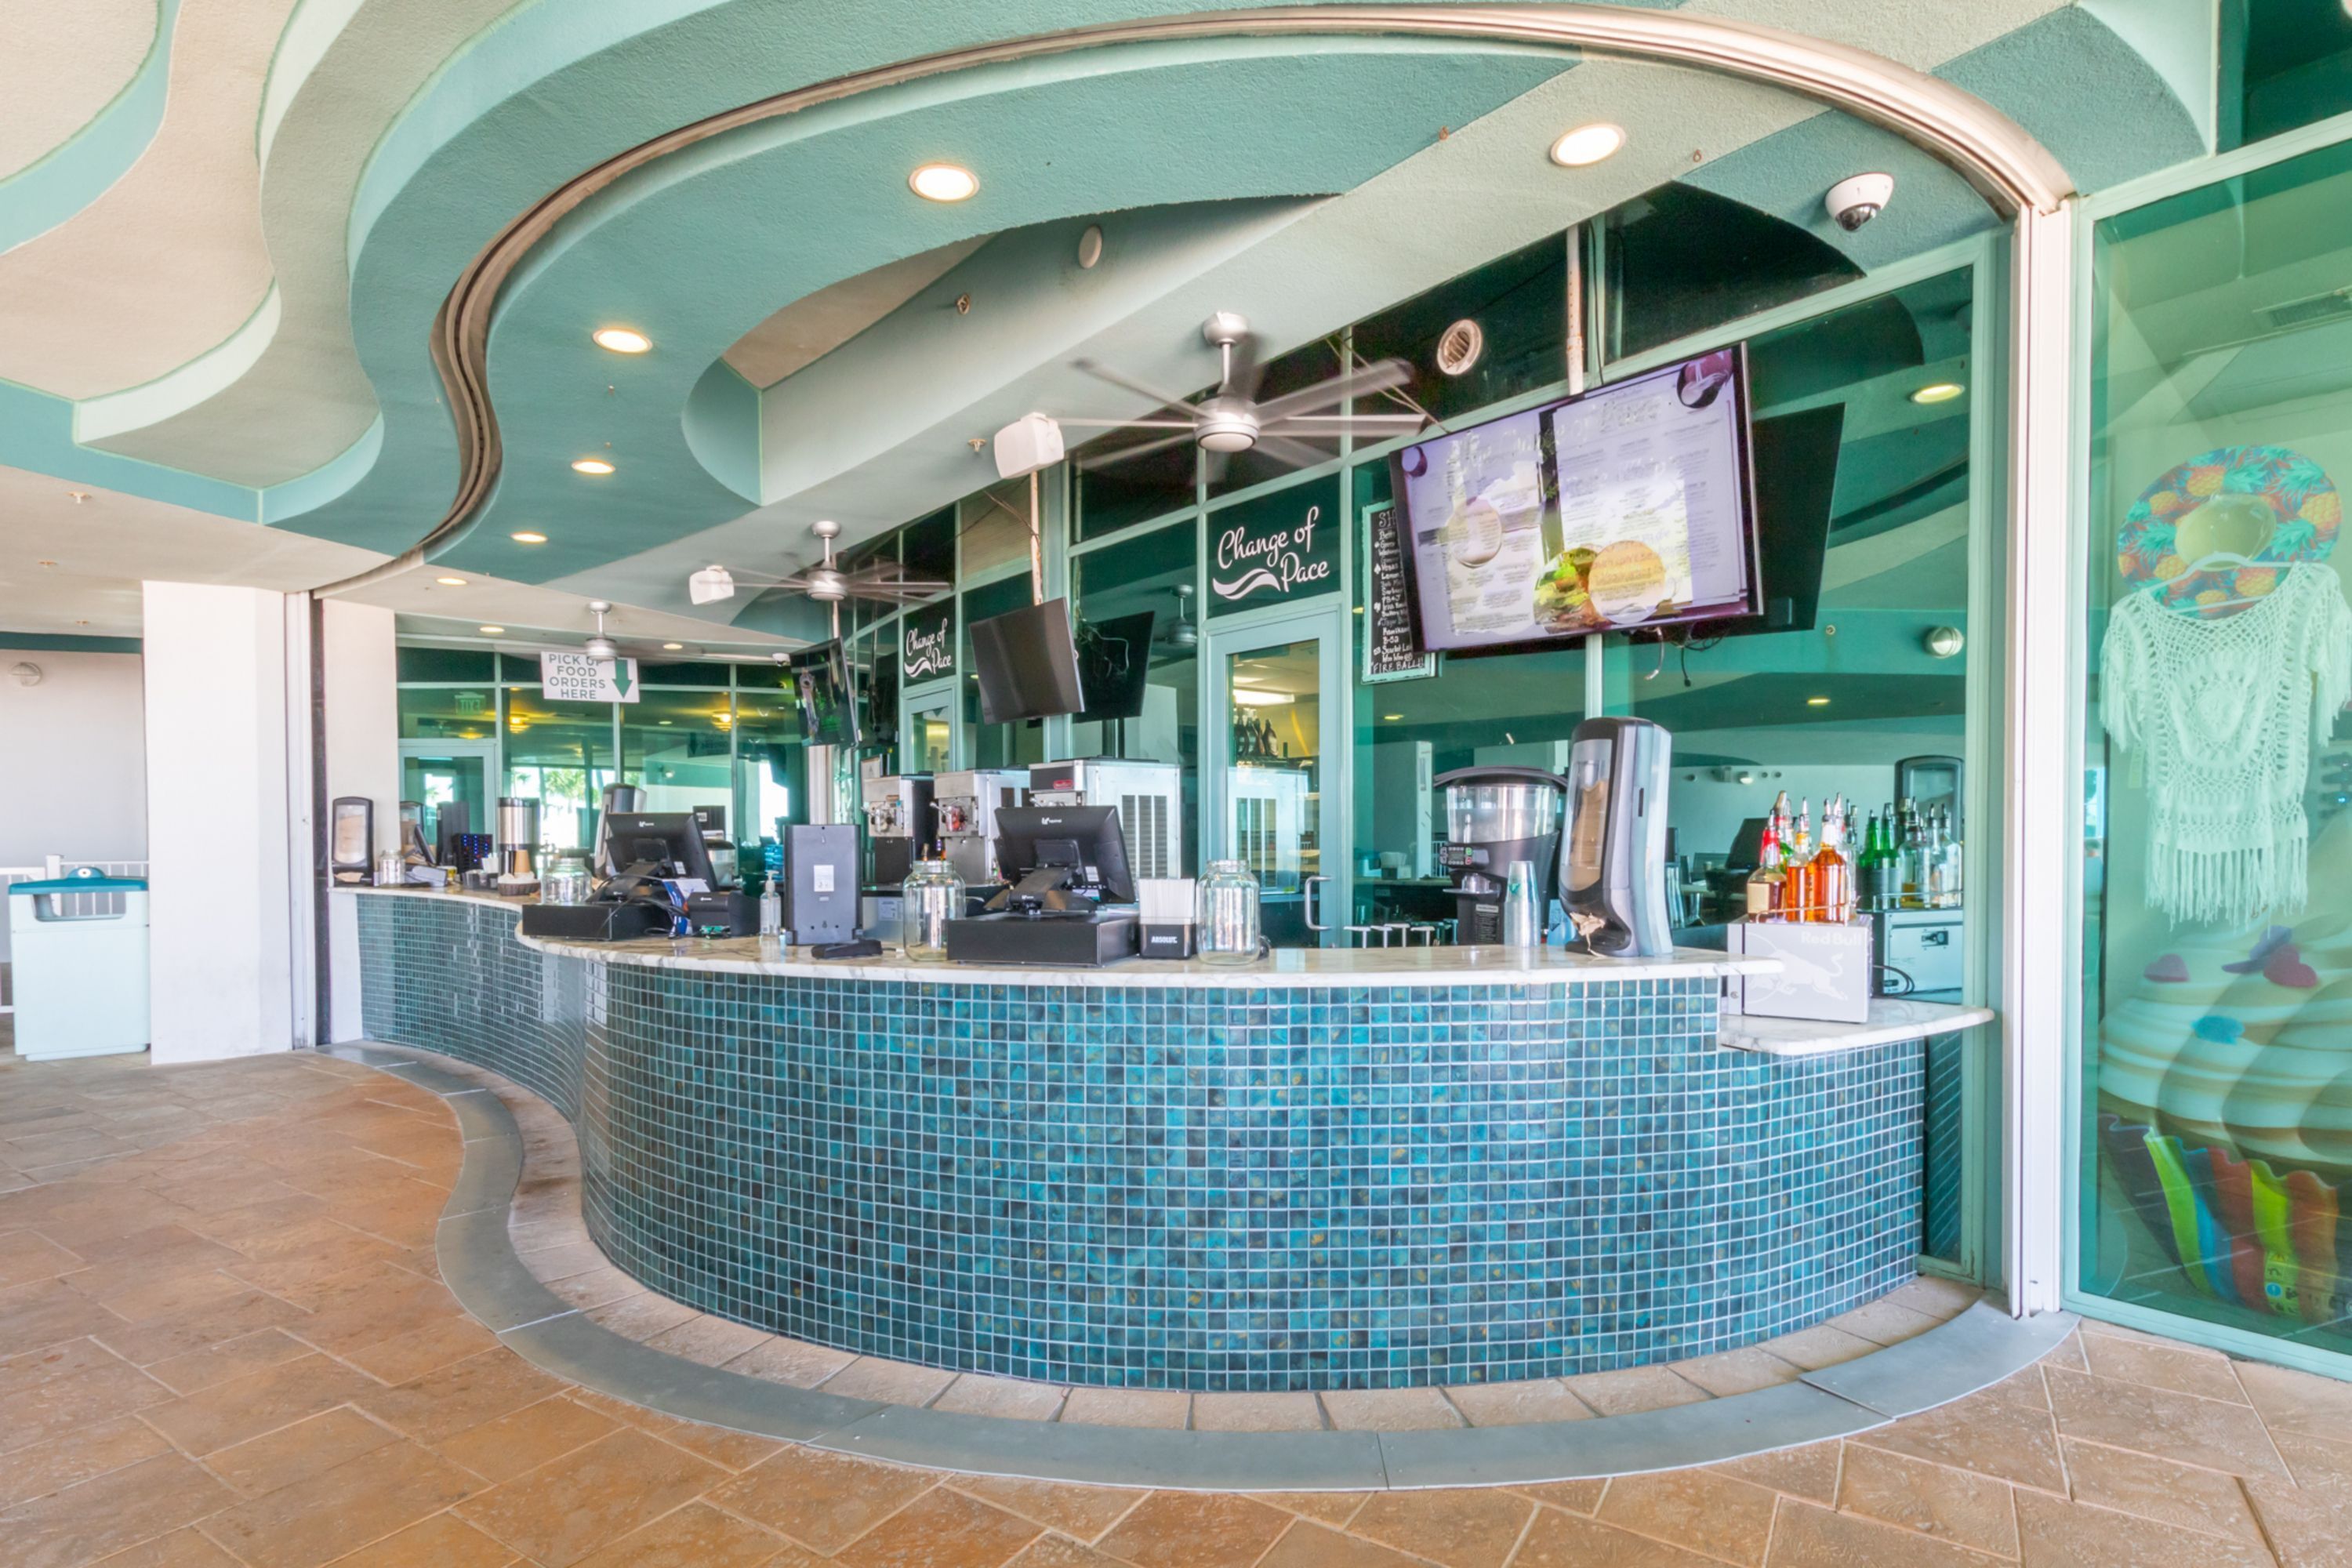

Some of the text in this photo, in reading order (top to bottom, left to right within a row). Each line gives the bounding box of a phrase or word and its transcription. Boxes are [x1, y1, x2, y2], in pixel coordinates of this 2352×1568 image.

[1218, 505, 1320, 571] Change of
[1279, 551, 1330, 593] Pace
[906, 617, 948, 657] Change of
[549, 654, 581, 666] PICK
[931, 648, 952, 675] Pace
[557, 666, 597, 677] FOOD
[549, 677, 606, 689] ORDERS
[561, 688, 597, 699] HERE
[1801, 931, 1862, 946] Red Bull
